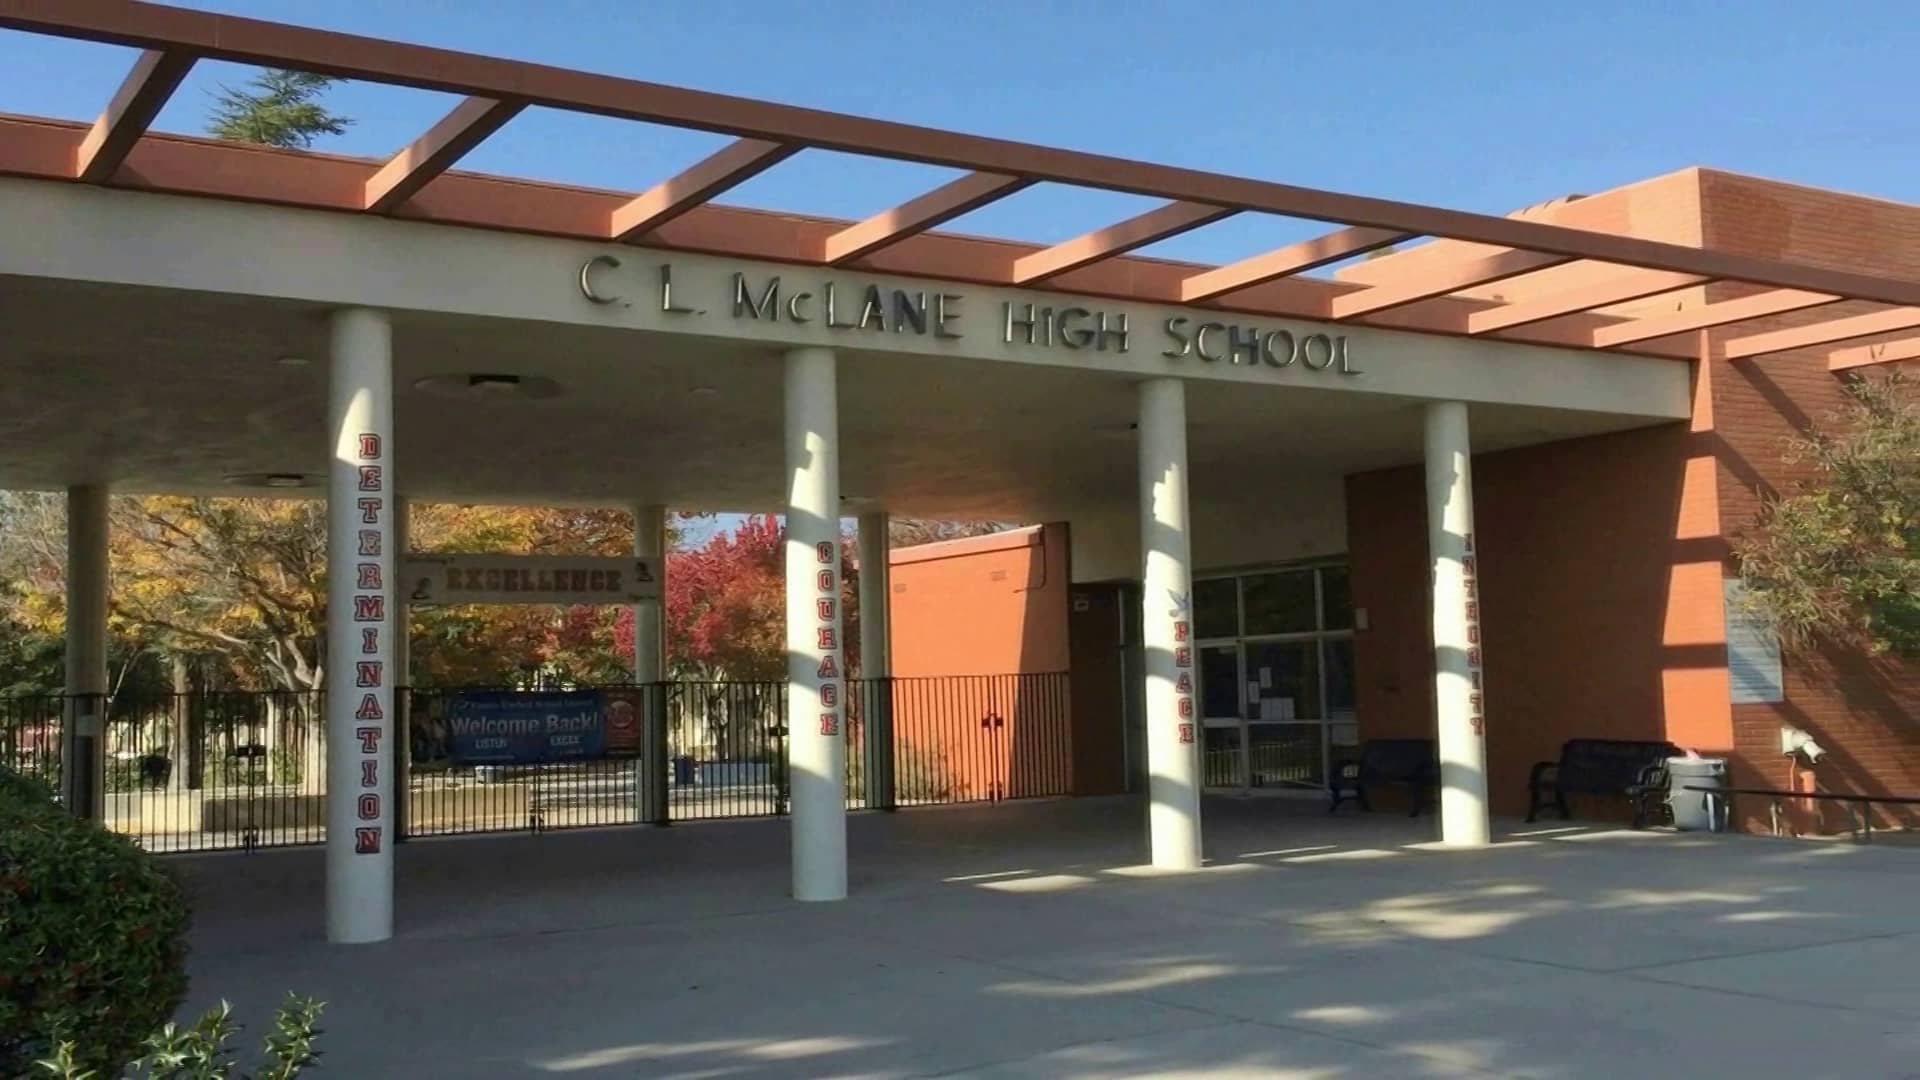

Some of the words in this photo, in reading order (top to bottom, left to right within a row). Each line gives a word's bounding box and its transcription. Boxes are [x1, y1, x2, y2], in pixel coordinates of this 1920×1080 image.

[578, 255, 631, 308] C.
[660, 264, 707, 315] L.
[733, 271, 964, 340] McLANE
[1003, 300, 1129, 353] HIGH
[1161, 316, 1365, 376] SCHOOL
[445, 567, 622, 592] EXCELLENCE
[816, 541, 838, 735] COURAGE
[354, 433, 385, 855] DETERMINATION
[1173, 621, 1195, 744] PEACE
[450, 714, 540, 736] Welcome
[546, 711, 599, 734] Back!
